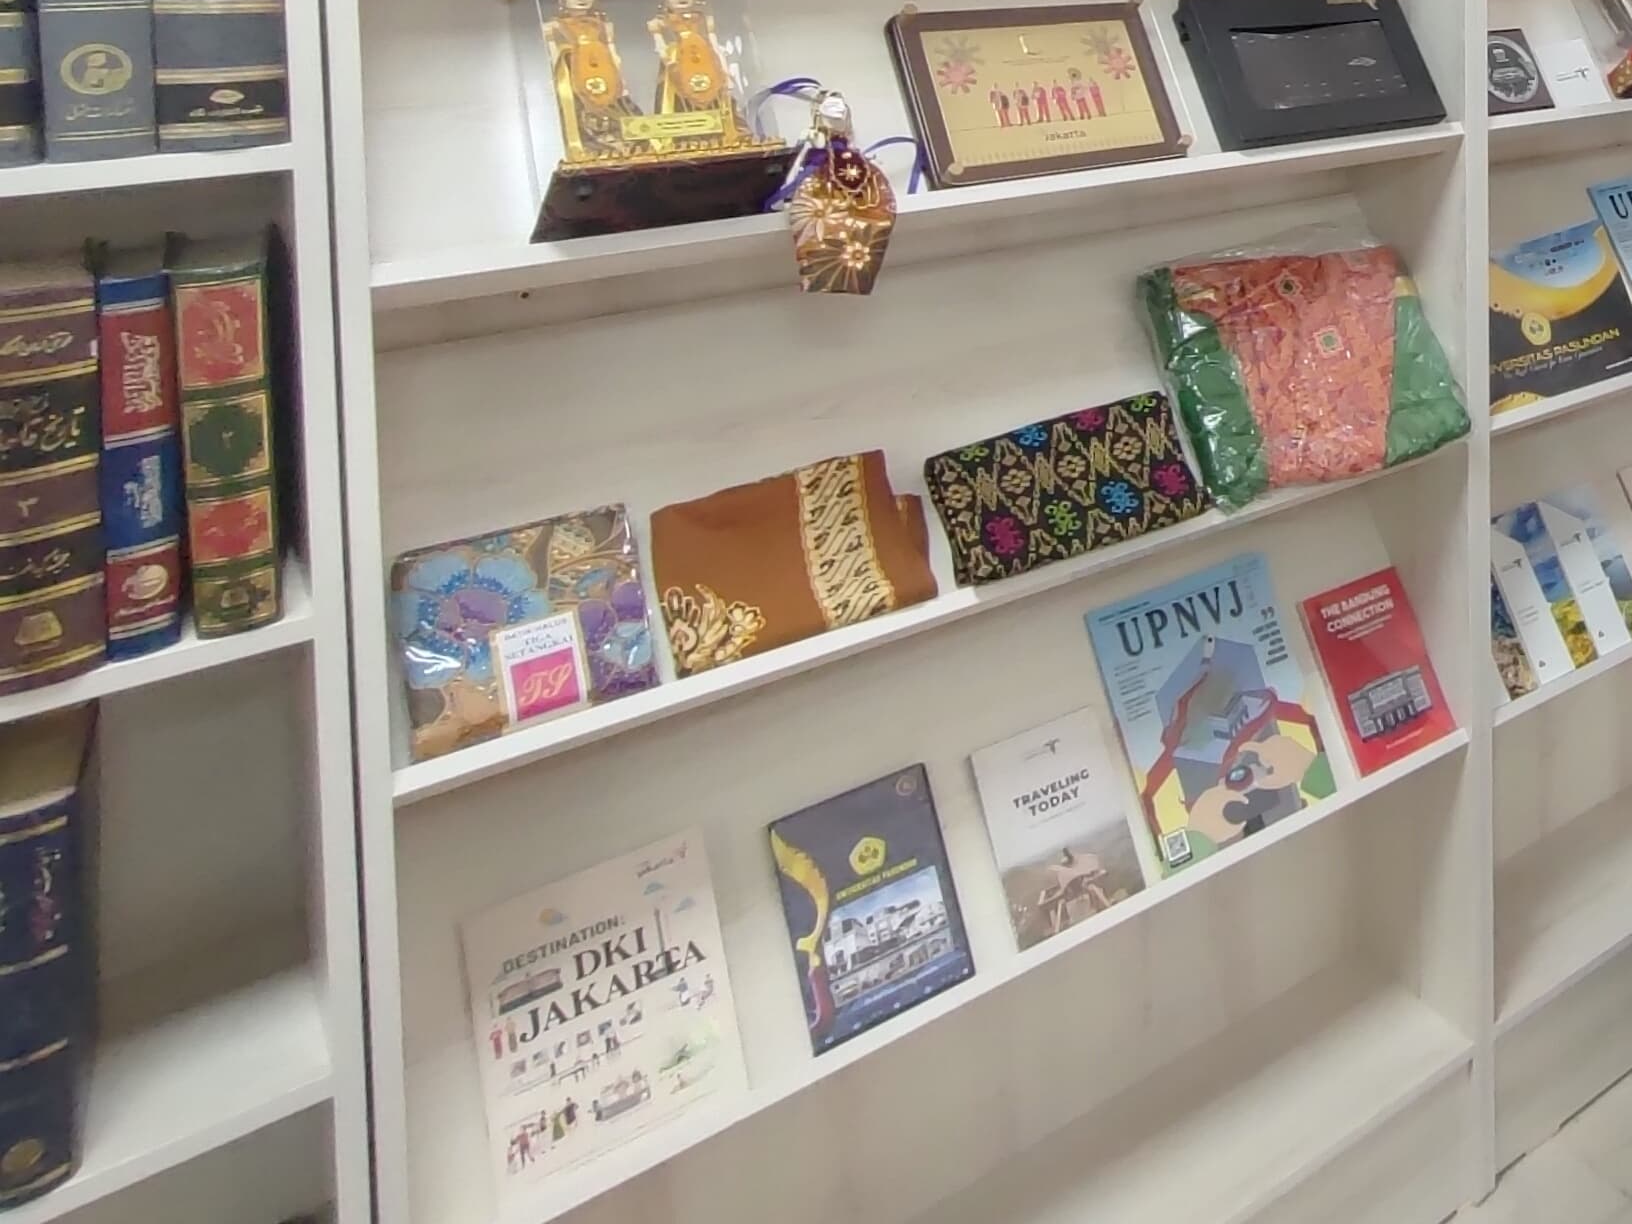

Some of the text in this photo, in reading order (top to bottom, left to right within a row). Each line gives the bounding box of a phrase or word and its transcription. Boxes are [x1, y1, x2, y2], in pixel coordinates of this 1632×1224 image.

[1116, 580, 1245, 657] UPNVJ
[1327, 597, 1395, 633] CONNECTION
[1013, 768, 1090, 809] TRAVELING
[1028, 786, 1079, 817] TODAY
[502, 914, 626, 976] DESTINATION:
[571, 926, 650, 983] DKI
[518, 939, 707, 1044] JAKARTA
